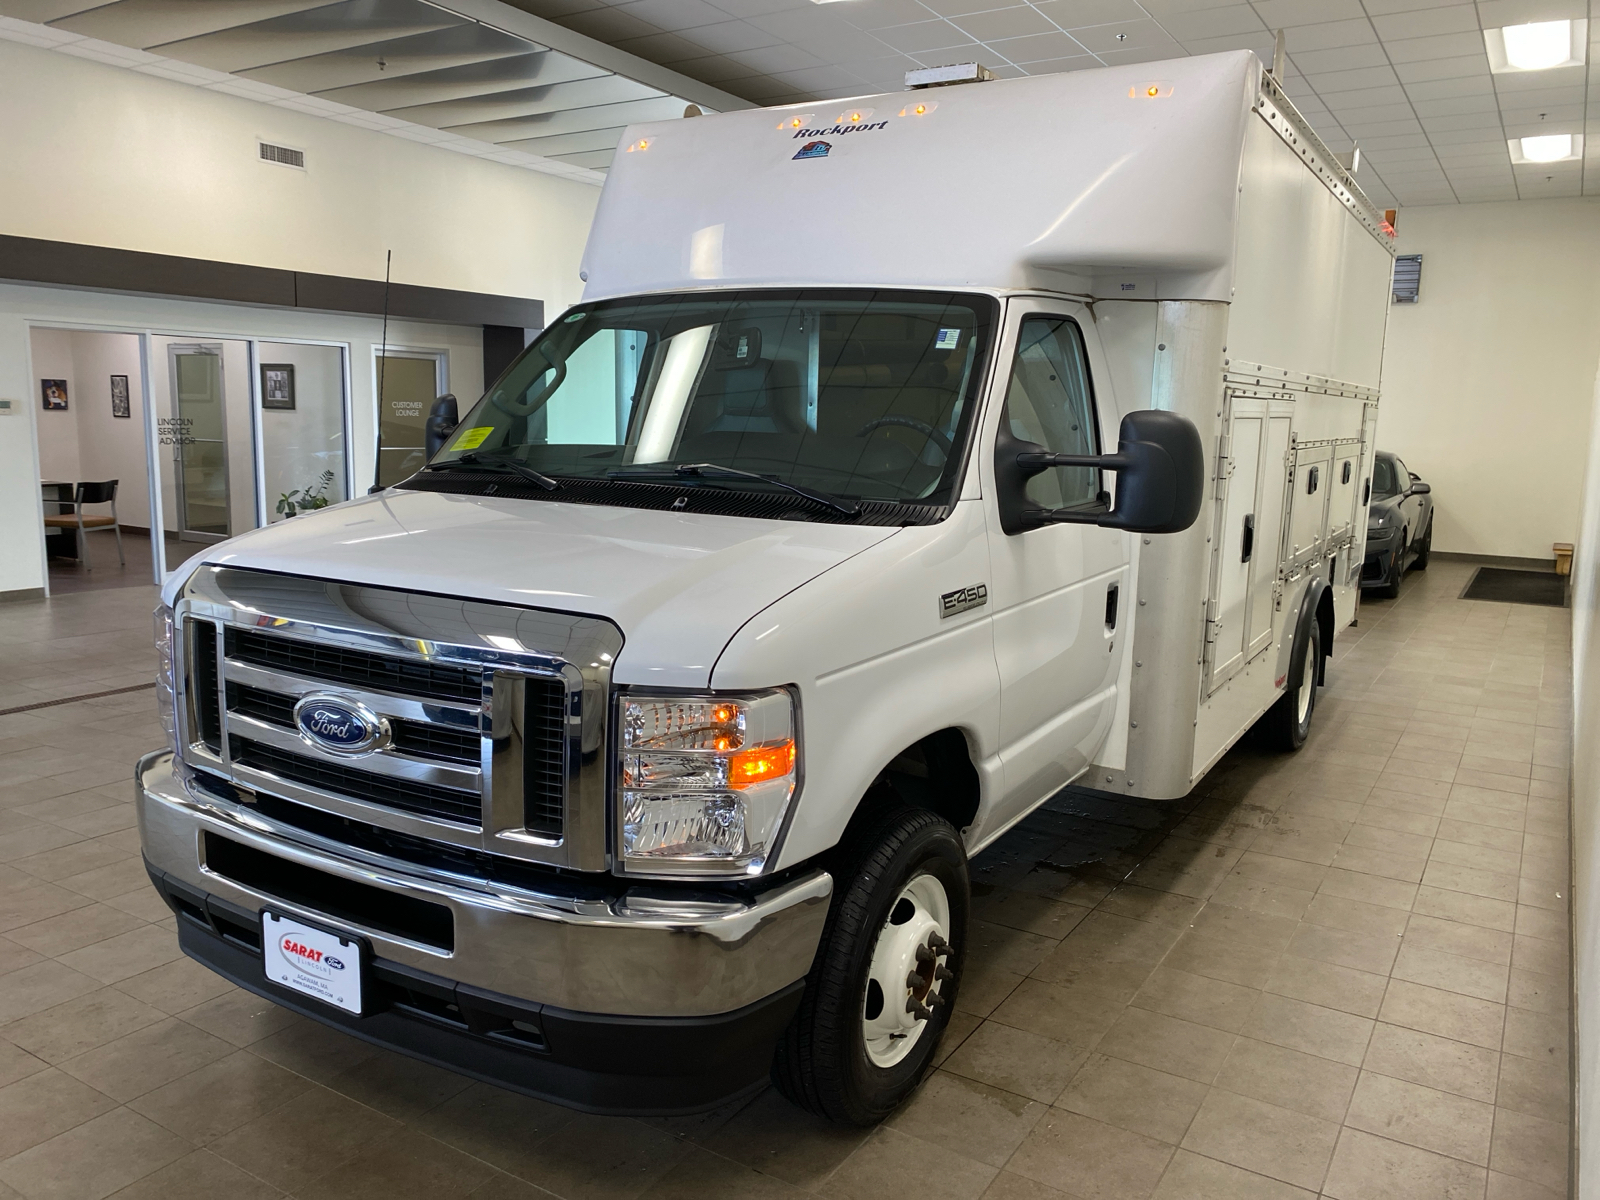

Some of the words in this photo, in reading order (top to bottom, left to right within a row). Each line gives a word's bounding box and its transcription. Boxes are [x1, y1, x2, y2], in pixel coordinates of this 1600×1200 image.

[792, 120, 889, 139] Rockport
[391, 401, 423, 409] CUSTOMER
[395, 409, 420, 417] LOUNGE
[157, 418, 194, 426] LINCOLN
[158, 427, 191, 436] SERVICE
[159, 437, 196, 445] ADVISOR
[310, 709, 350, 739] Ford
[283, 938, 323, 963] SARAT
[301, 959, 328, 973] LINCOLN
[326, 956, 343, 970] Ford
